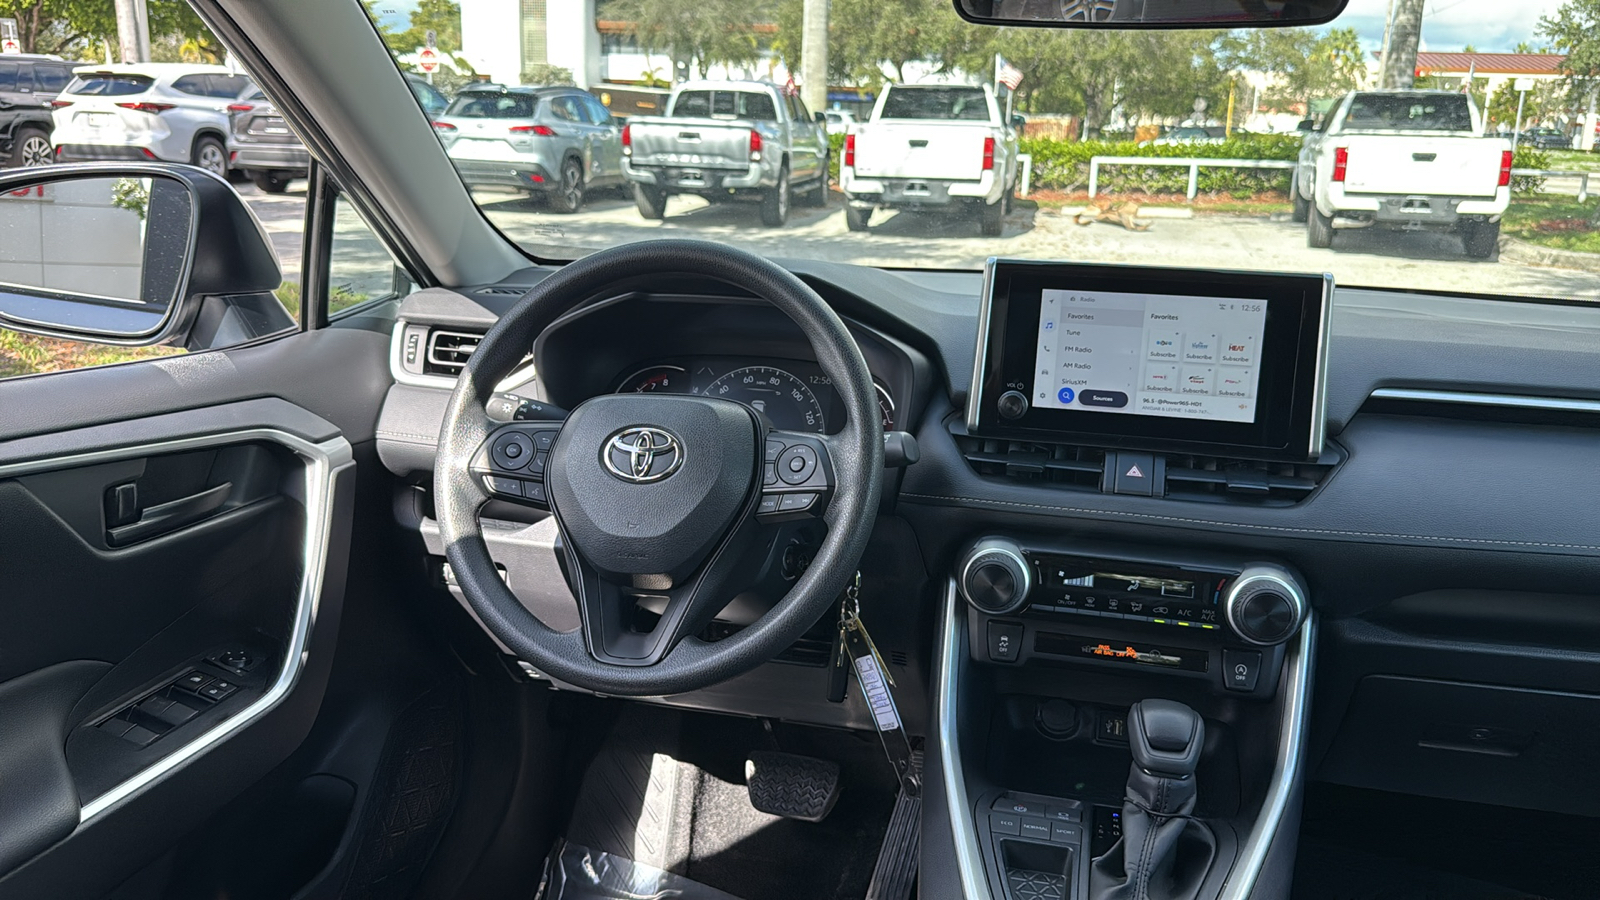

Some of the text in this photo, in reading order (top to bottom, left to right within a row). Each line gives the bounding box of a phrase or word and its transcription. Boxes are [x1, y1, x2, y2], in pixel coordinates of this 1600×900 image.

[1241, 304, 1261, 312] 12:56
[1067, 312, 1094, 320] Favorites
[1150, 313, 1179, 321] Favorites
[1222, 355, 1249, 363] Subscribe
[662, 378, 669, 387] 8
[743, 375, 754, 384] 60
[769, 376, 780, 386] 80
[809, 375, 832, 385] 12:56
[1061, 378, 1087, 386] SiriusXM
[719, 385, 729, 395] 40
[790, 388, 804, 402] 100
[805, 410, 815, 425] 120
[1177, 609, 1192, 617] A/C
[1023, 823, 1048, 832] NORMAL
